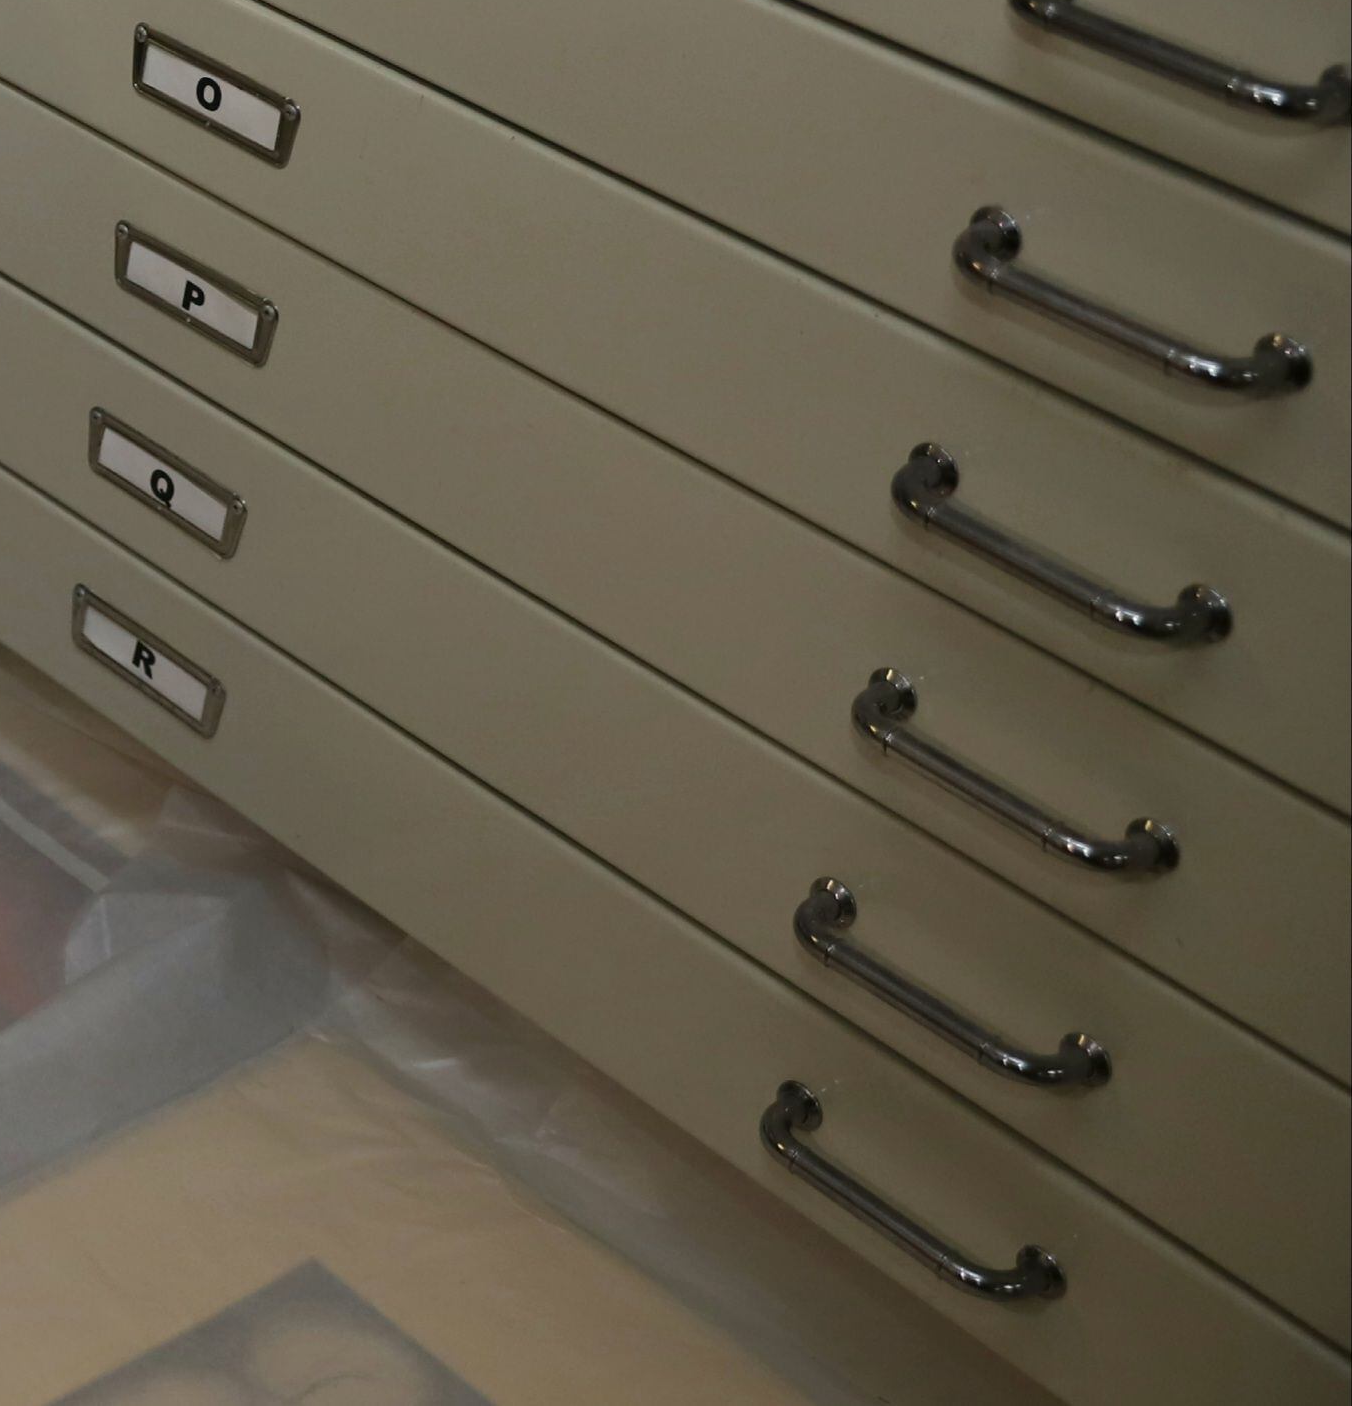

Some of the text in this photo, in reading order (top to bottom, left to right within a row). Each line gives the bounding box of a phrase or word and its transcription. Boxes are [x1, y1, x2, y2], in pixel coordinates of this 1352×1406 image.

[196, 76, 222, 112] O
[182, 280, 205, 311] P
[150, 469, 175, 508] Q
[131, 641, 155, 679] R
